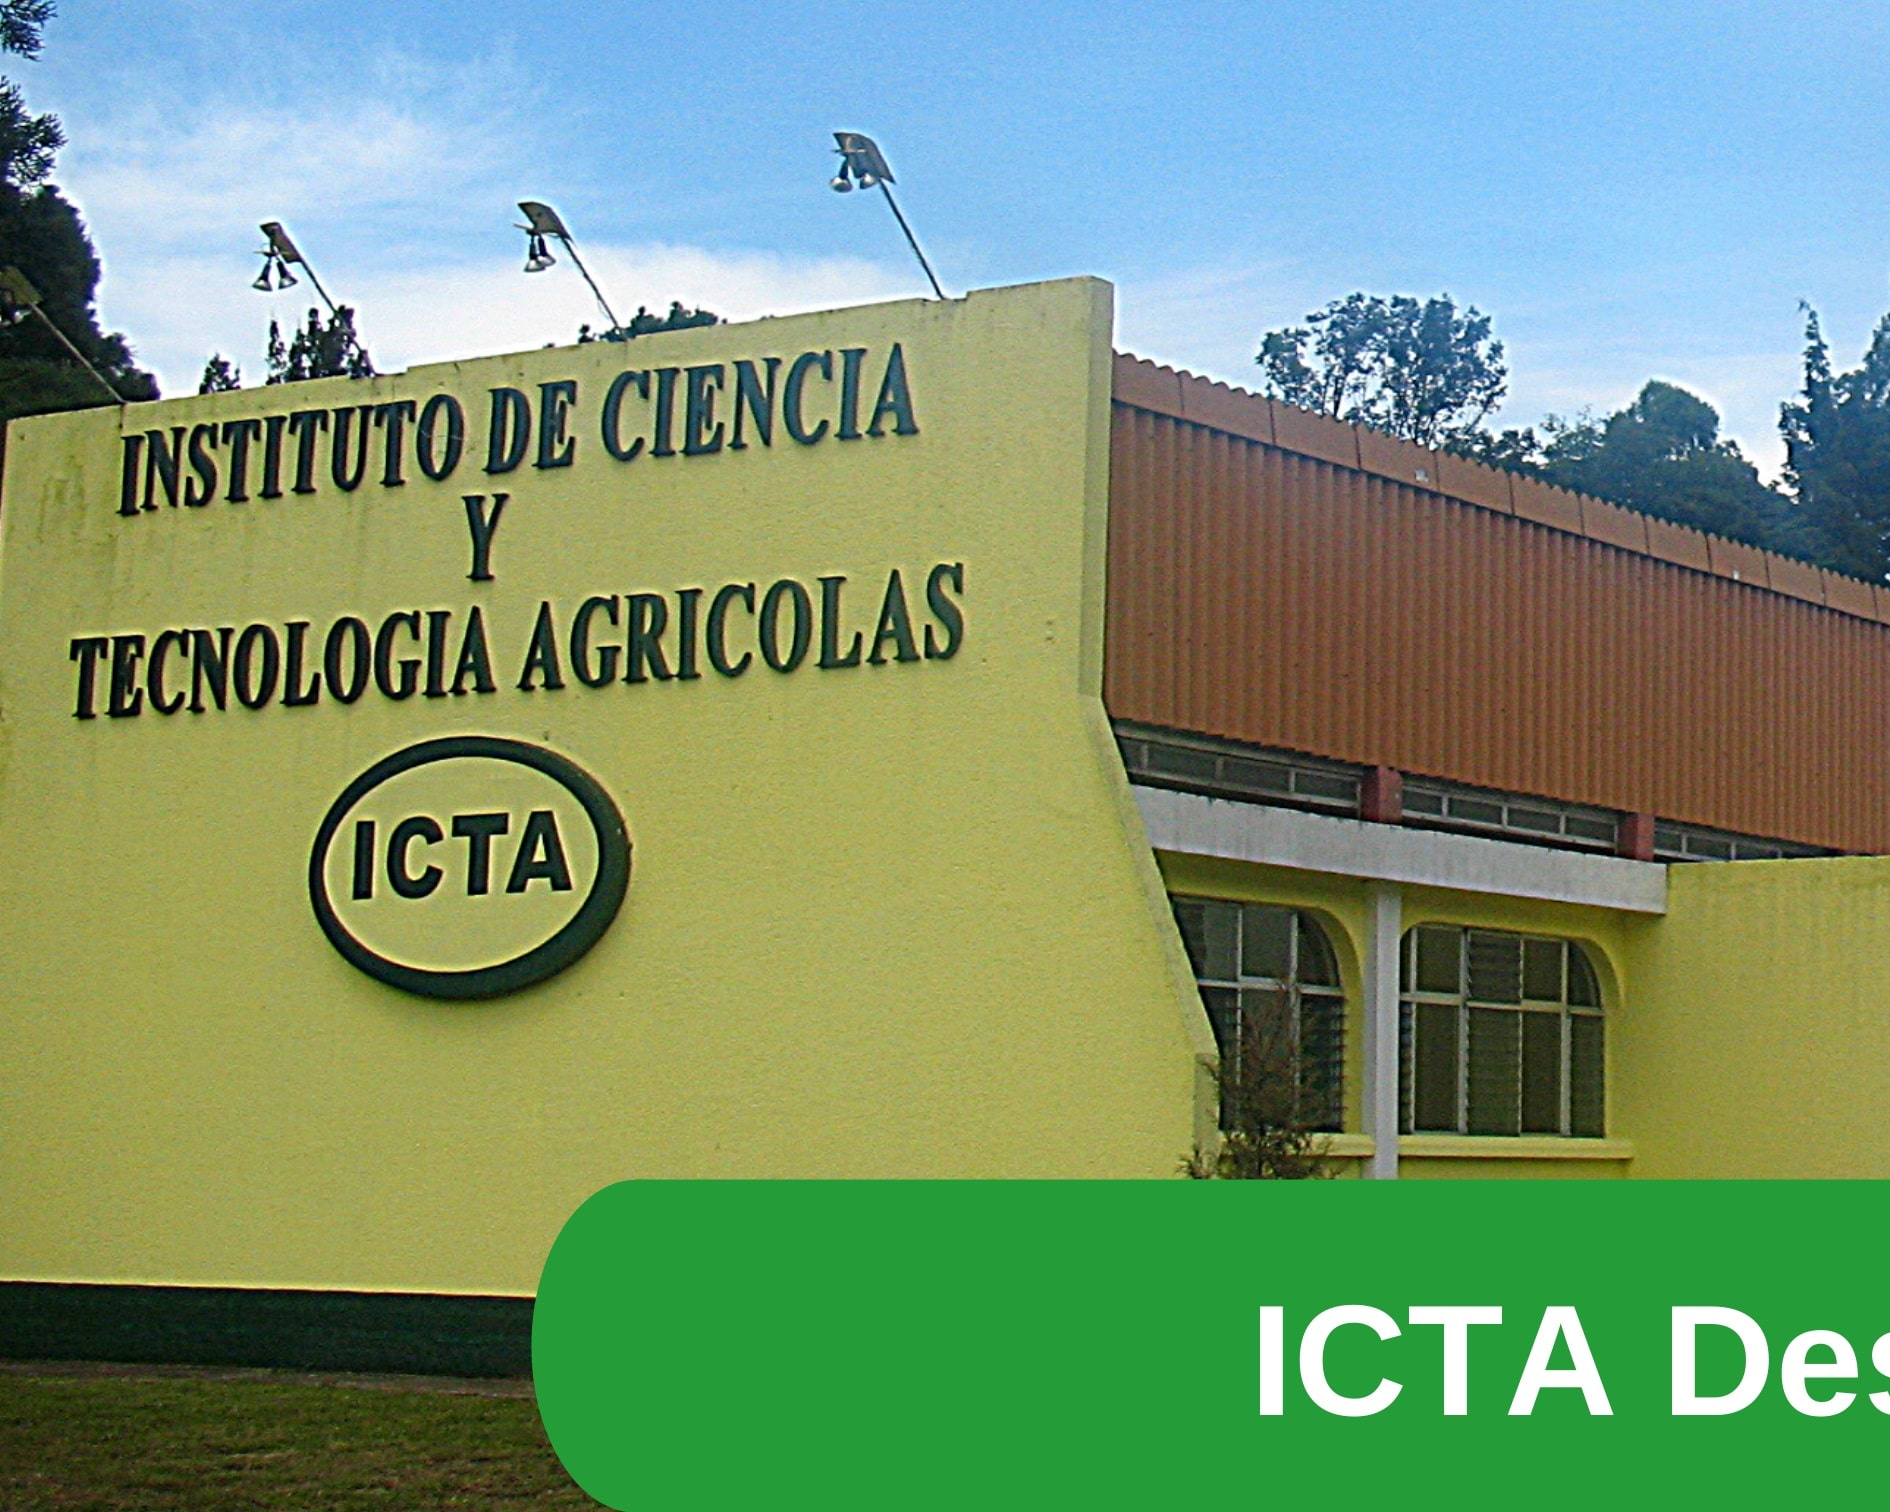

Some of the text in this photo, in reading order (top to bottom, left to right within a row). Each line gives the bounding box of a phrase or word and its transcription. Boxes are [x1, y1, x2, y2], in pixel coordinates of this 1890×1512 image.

[117, 342, 919, 516] INSTITUTO DE CIENCIA
[462, 492, 510, 583] Y
[69, 562, 965, 720] TECNOLOGIA AGRICOLAS
[352, 810, 572, 901] ICTA
